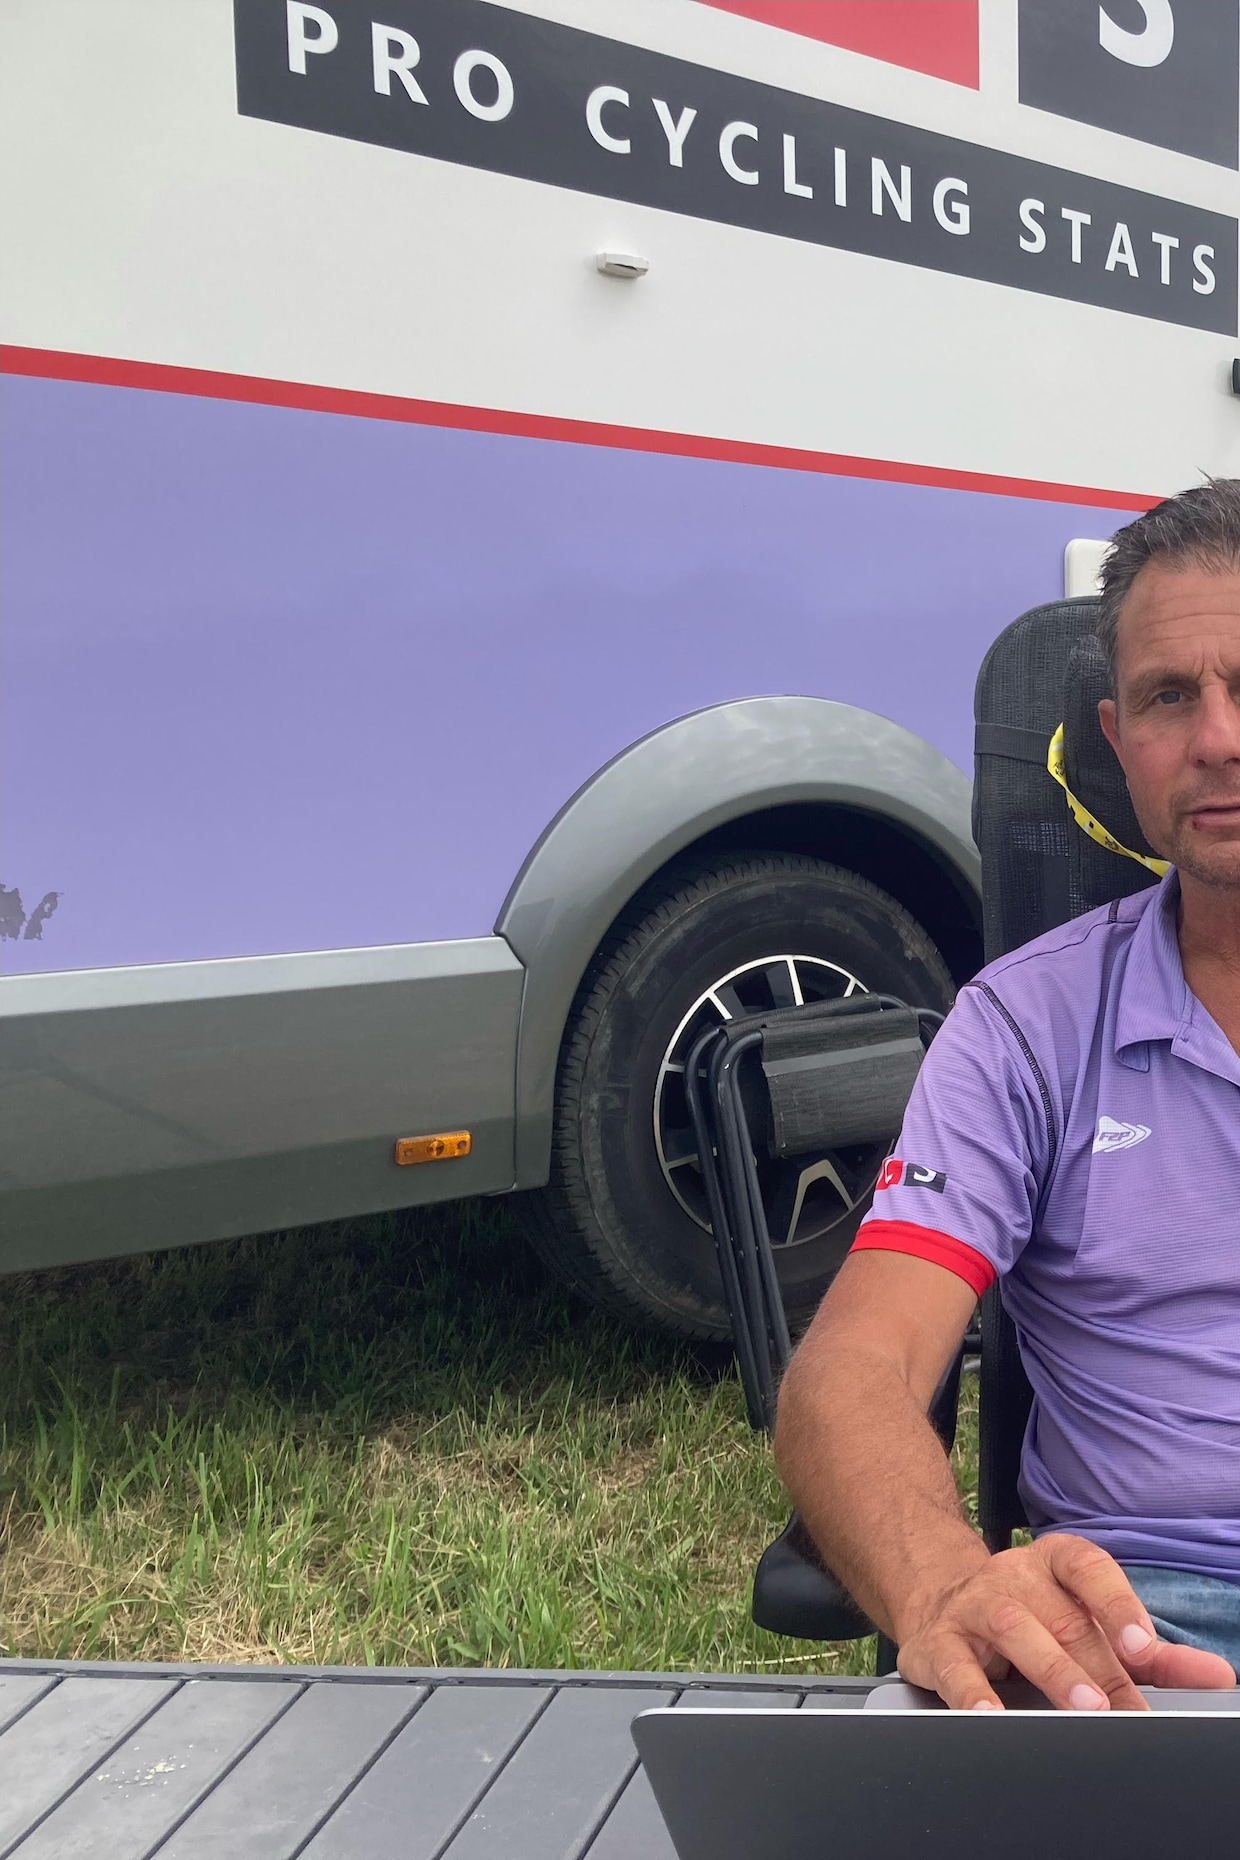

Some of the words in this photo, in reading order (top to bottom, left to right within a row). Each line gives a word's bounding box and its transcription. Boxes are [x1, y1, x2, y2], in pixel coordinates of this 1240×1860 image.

[287, 0, 515, 122] PRO
[586, 86, 971, 236] CYCLING
[1018, 198, 1216, 295] STATS
